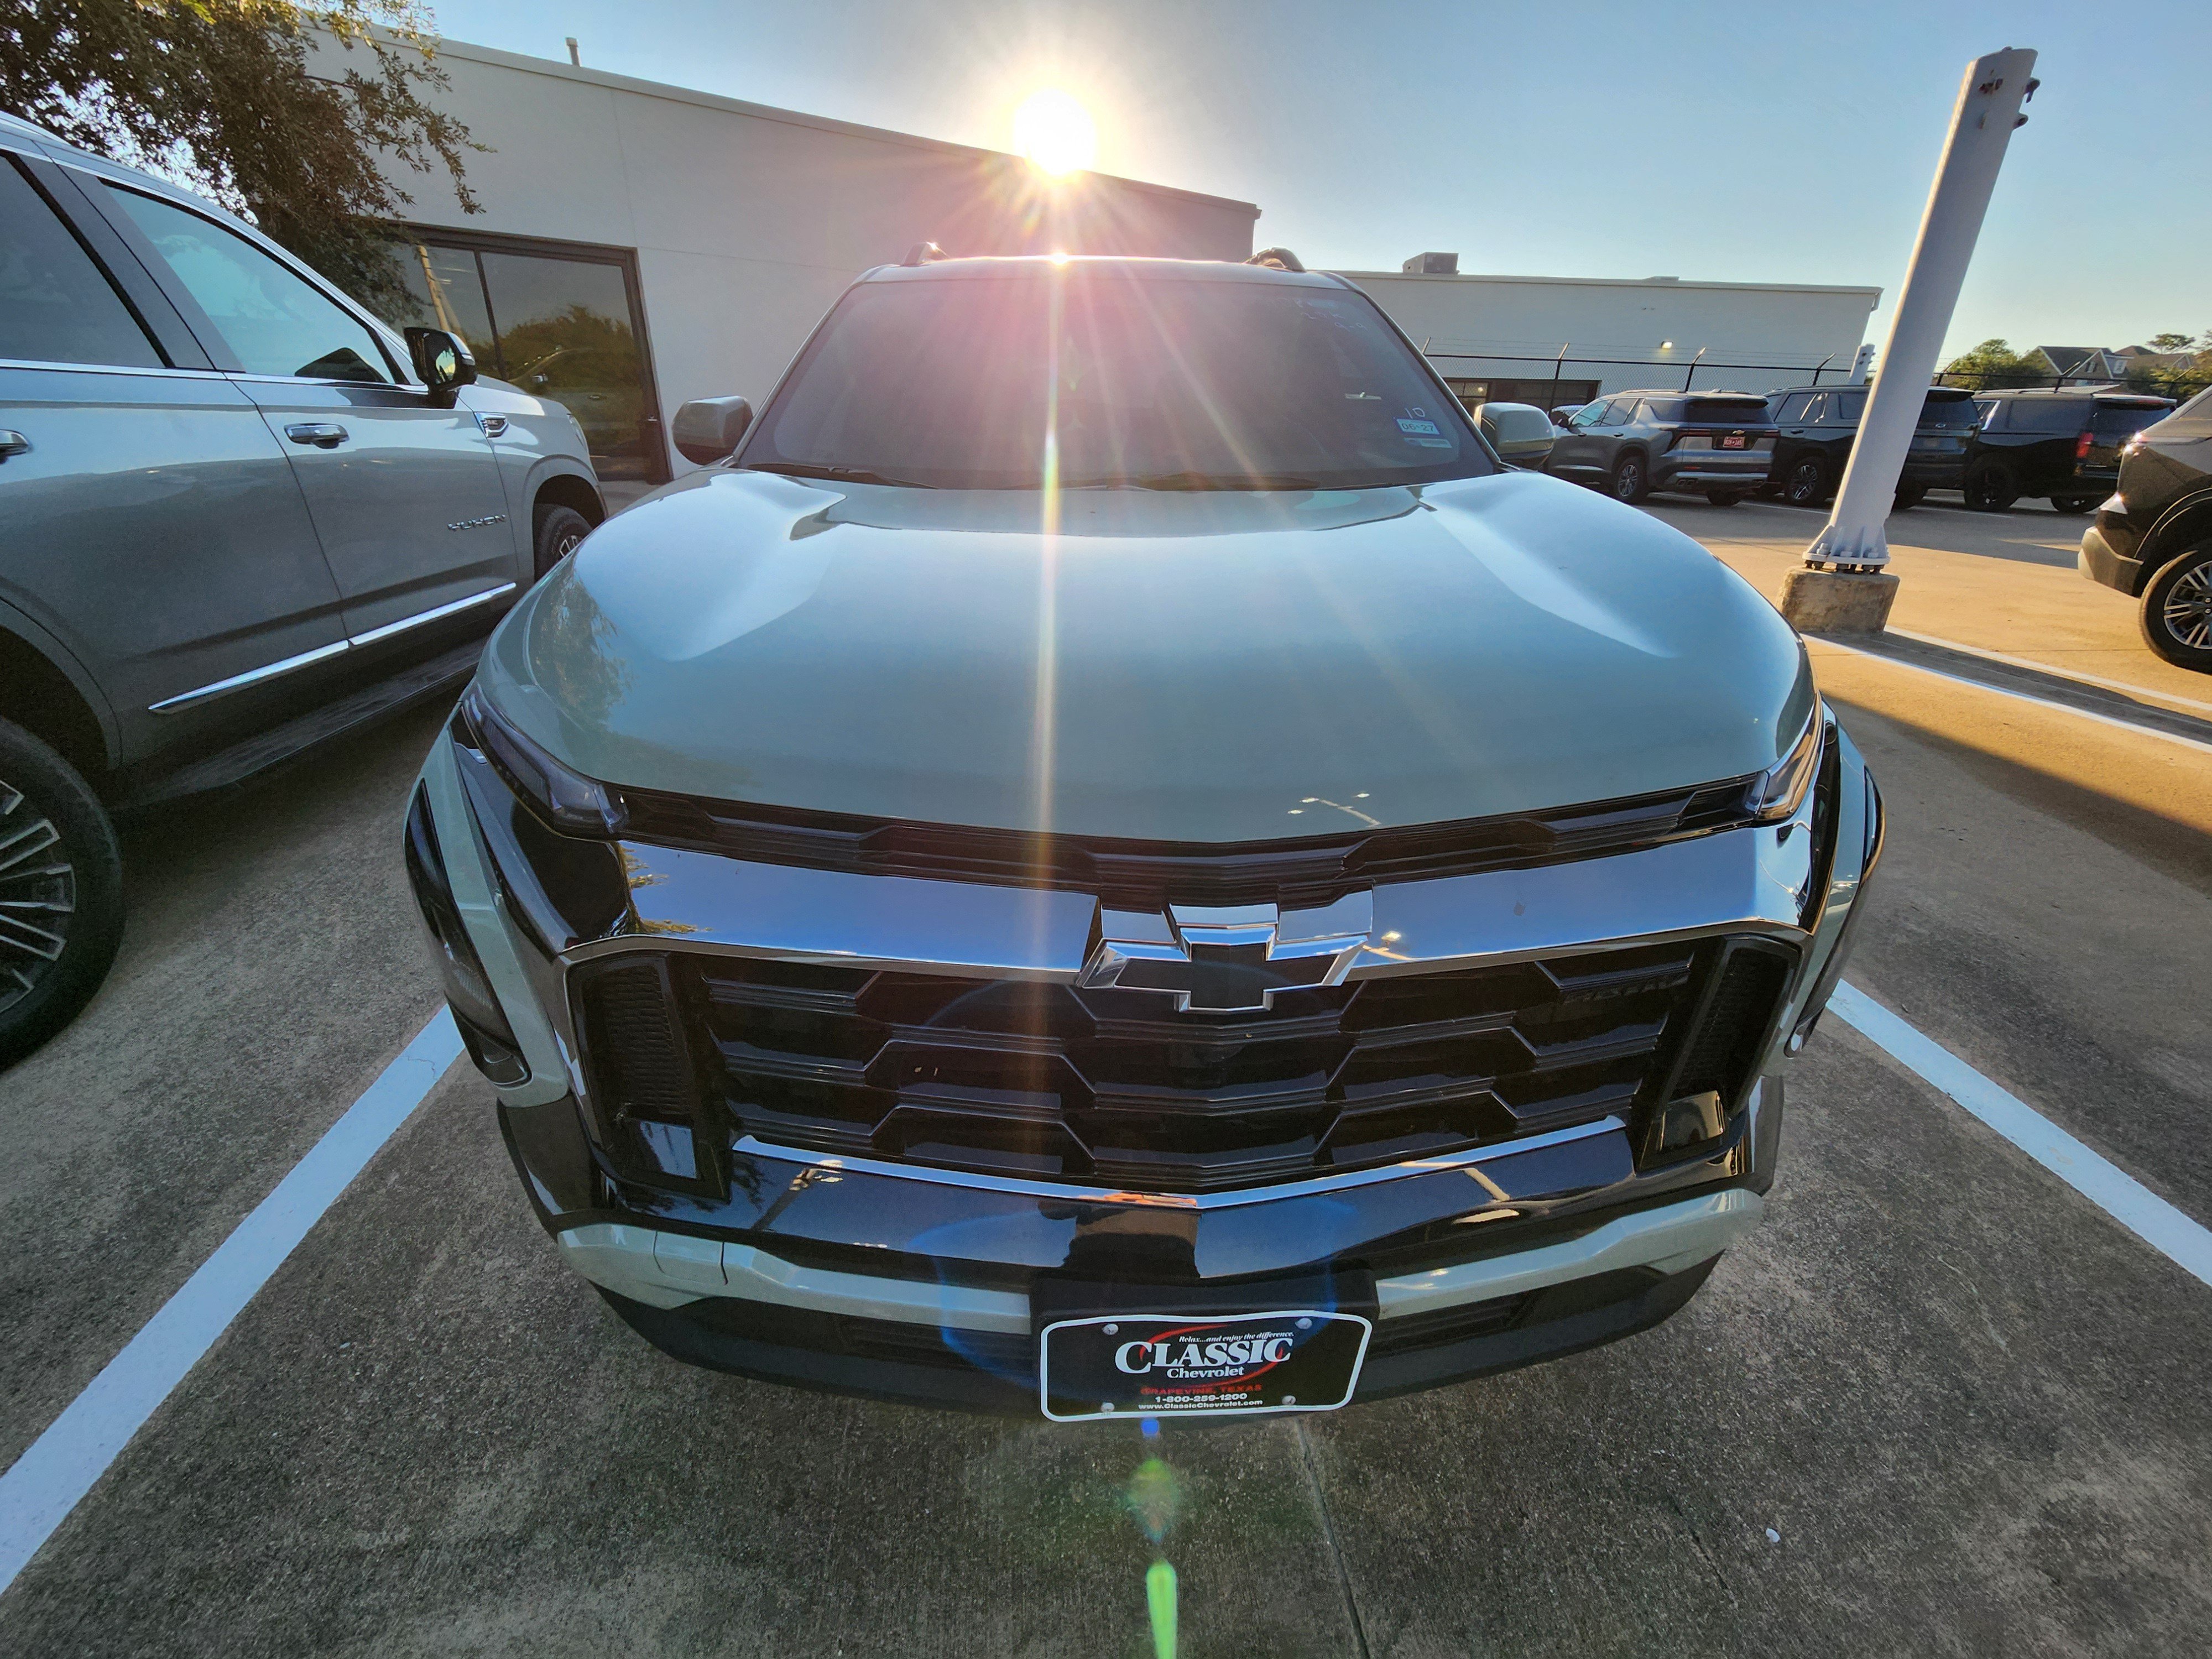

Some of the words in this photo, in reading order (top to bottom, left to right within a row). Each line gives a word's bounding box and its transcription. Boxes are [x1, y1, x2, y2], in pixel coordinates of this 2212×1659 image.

[1222, 1334, 1243, 1343] enjoy
[1166, 1366, 1245, 1378] Chevrolet
[1220, 1384, 1262, 1393] TEXAS
